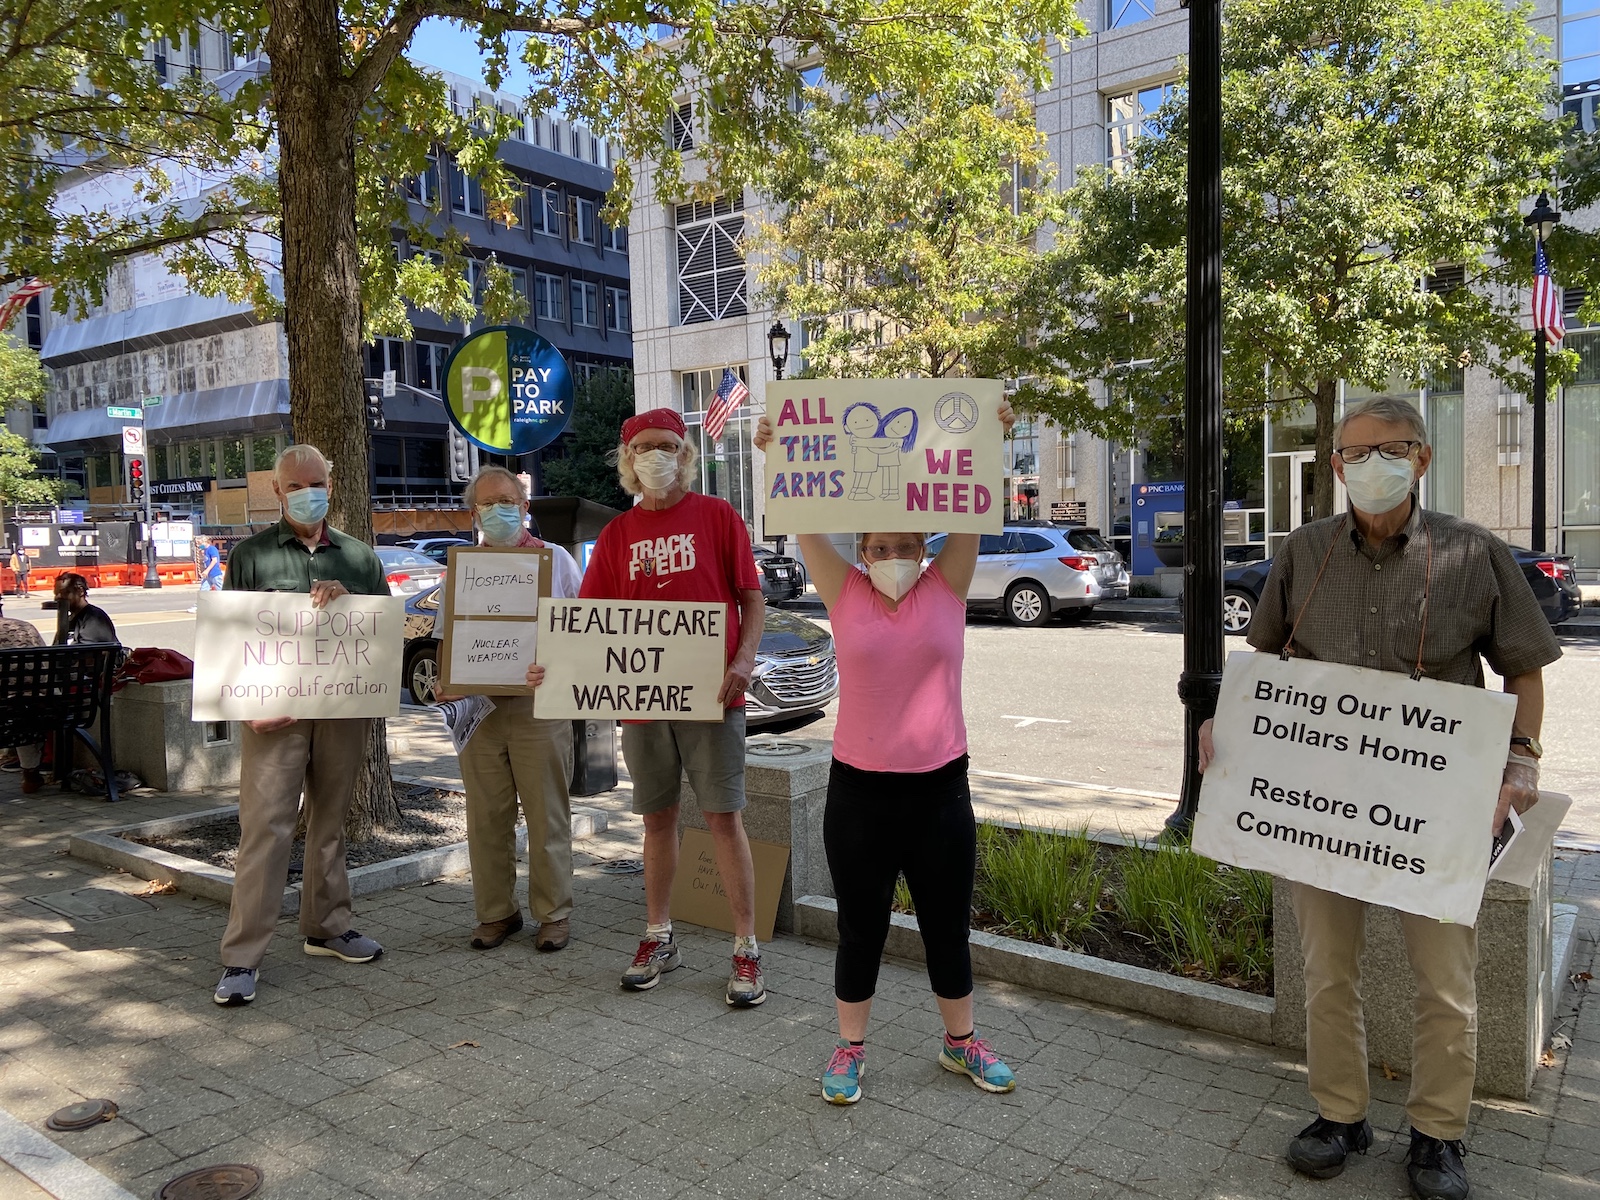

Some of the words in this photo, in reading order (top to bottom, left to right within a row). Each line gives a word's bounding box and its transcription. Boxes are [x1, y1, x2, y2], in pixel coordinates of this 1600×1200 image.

[512, 367, 551, 382] PAY
[461, 366, 500, 413] P
[512, 383, 540, 398] TO
[513, 400, 564, 414] PARK
[777, 397, 834, 427] ALL
[779, 434, 837, 462] THE
[925, 448, 973, 476] WE
[770, 469, 845, 499] ARMS
[906, 482, 992, 515] NEED
[629, 534, 696, 560] TRACK
[629, 549, 696, 581] FELD
[256, 609, 383, 637] SUPPORT
[550, 606, 721, 637] HEALTHCARE
[244, 638, 371, 667] NUCLEAR
[467, 652, 519, 663] WEAPONS
[472, 638, 519, 650] NUCLEAR
[606, 647, 665, 674] NOT
[572, 684, 694, 712] WARFARE
[1254, 680, 1327, 716] Bring
[1337, 694, 1392, 722] Our
[1401, 704, 1462, 735] War
[1252, 715, 1349, 752] Dollars
[1359, 734, 1448, 771] Home
[1250, 776, 1358, 820] Restore
[1368, 803, 1427, 835] Our
[1236, 811, 1426, 875] Communities
[692, 877, 709, 890] Our
